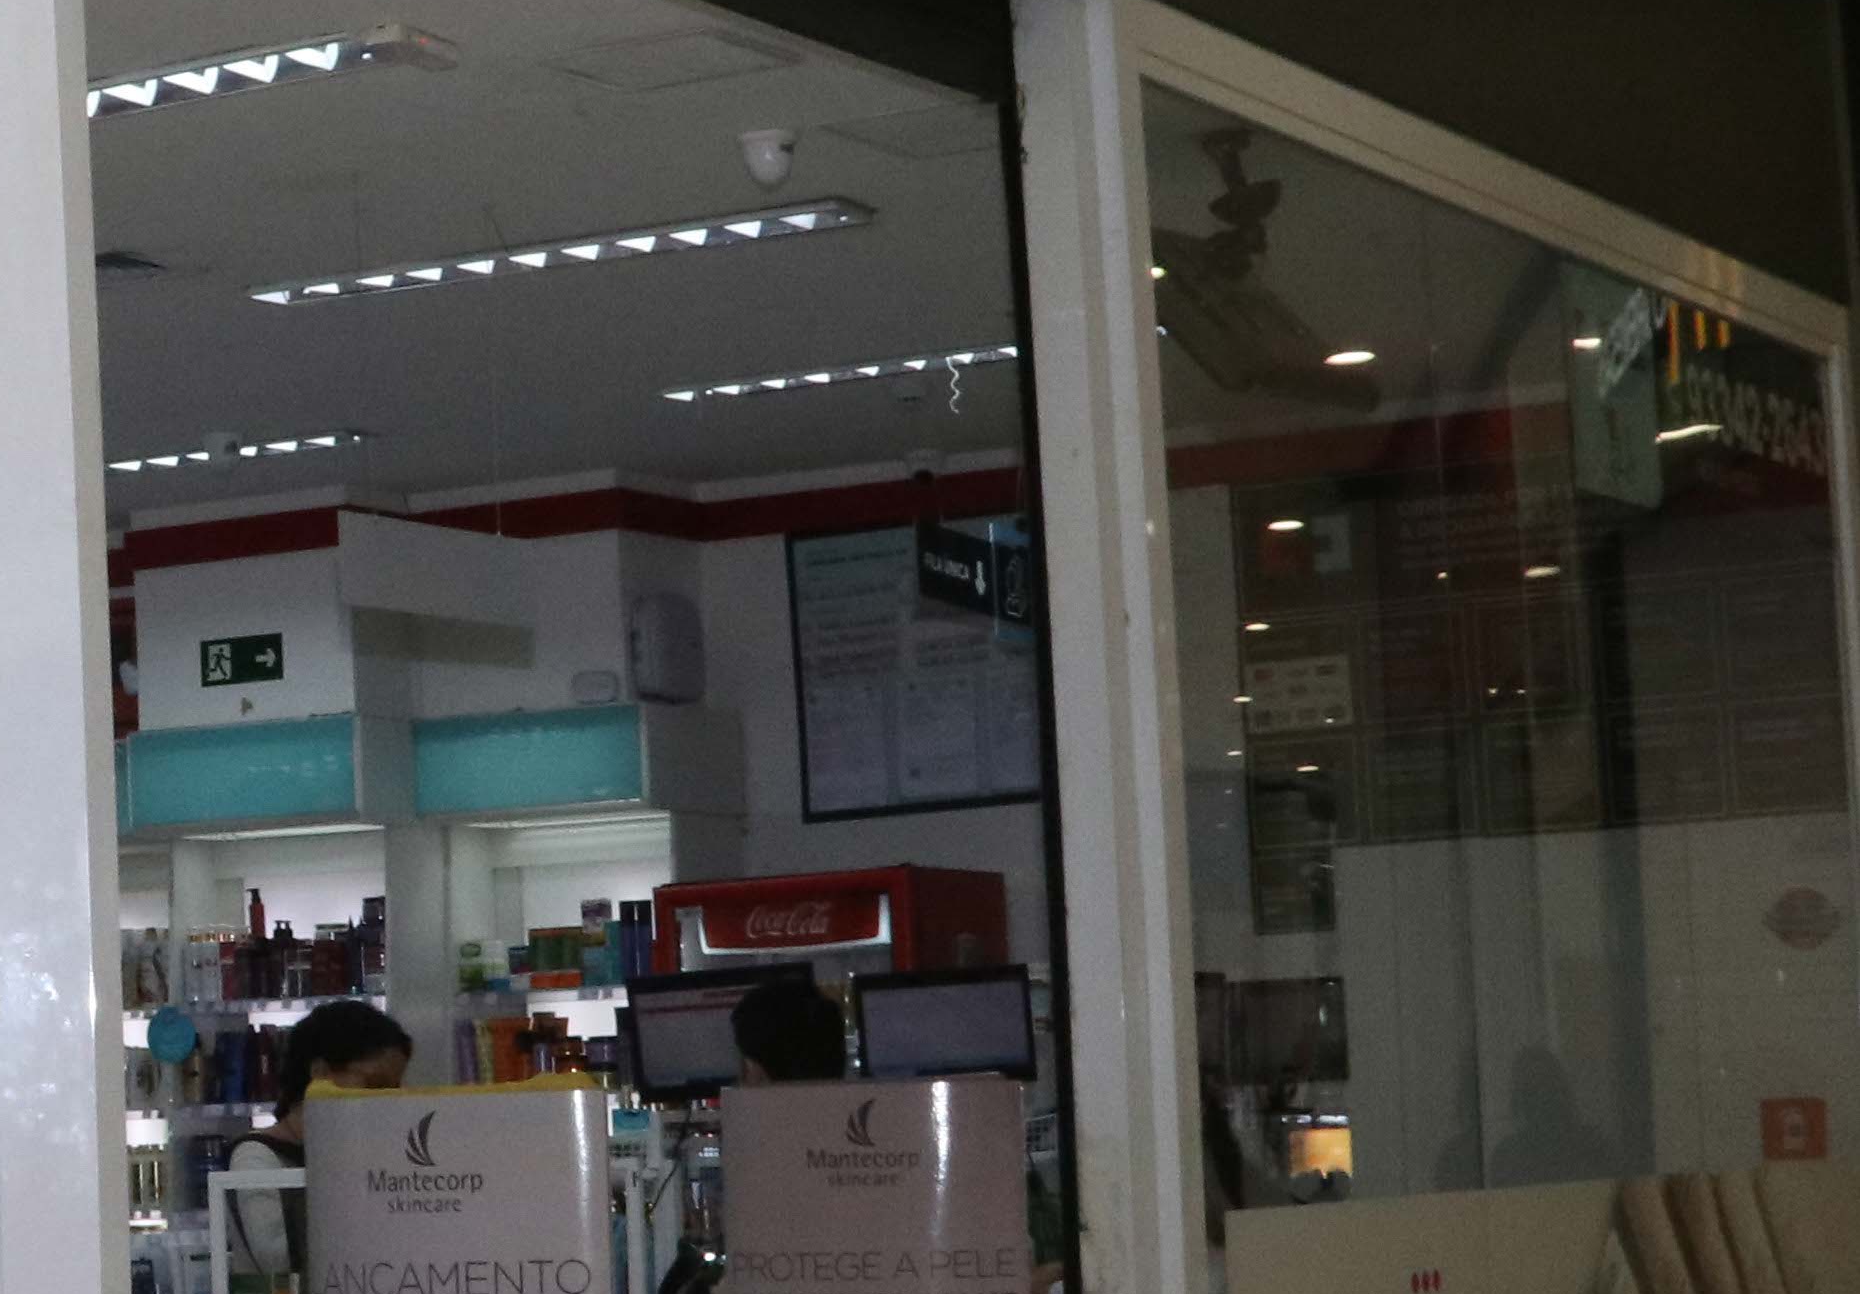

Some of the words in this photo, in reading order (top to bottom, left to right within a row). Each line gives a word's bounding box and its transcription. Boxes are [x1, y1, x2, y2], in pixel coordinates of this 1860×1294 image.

[805, 1147, 920, 1172] Mantecorp
[366, 1169, 484, 1195] Mantecorp
[826, 1172, 900, 1189] skincare
[386, 1196, 463, 1214] skincare
[731, 1249, 877, 1283] PROTEGE
[891, 1251, 920, 1280] A
[928, 1247, 1018, 1280] PELE
